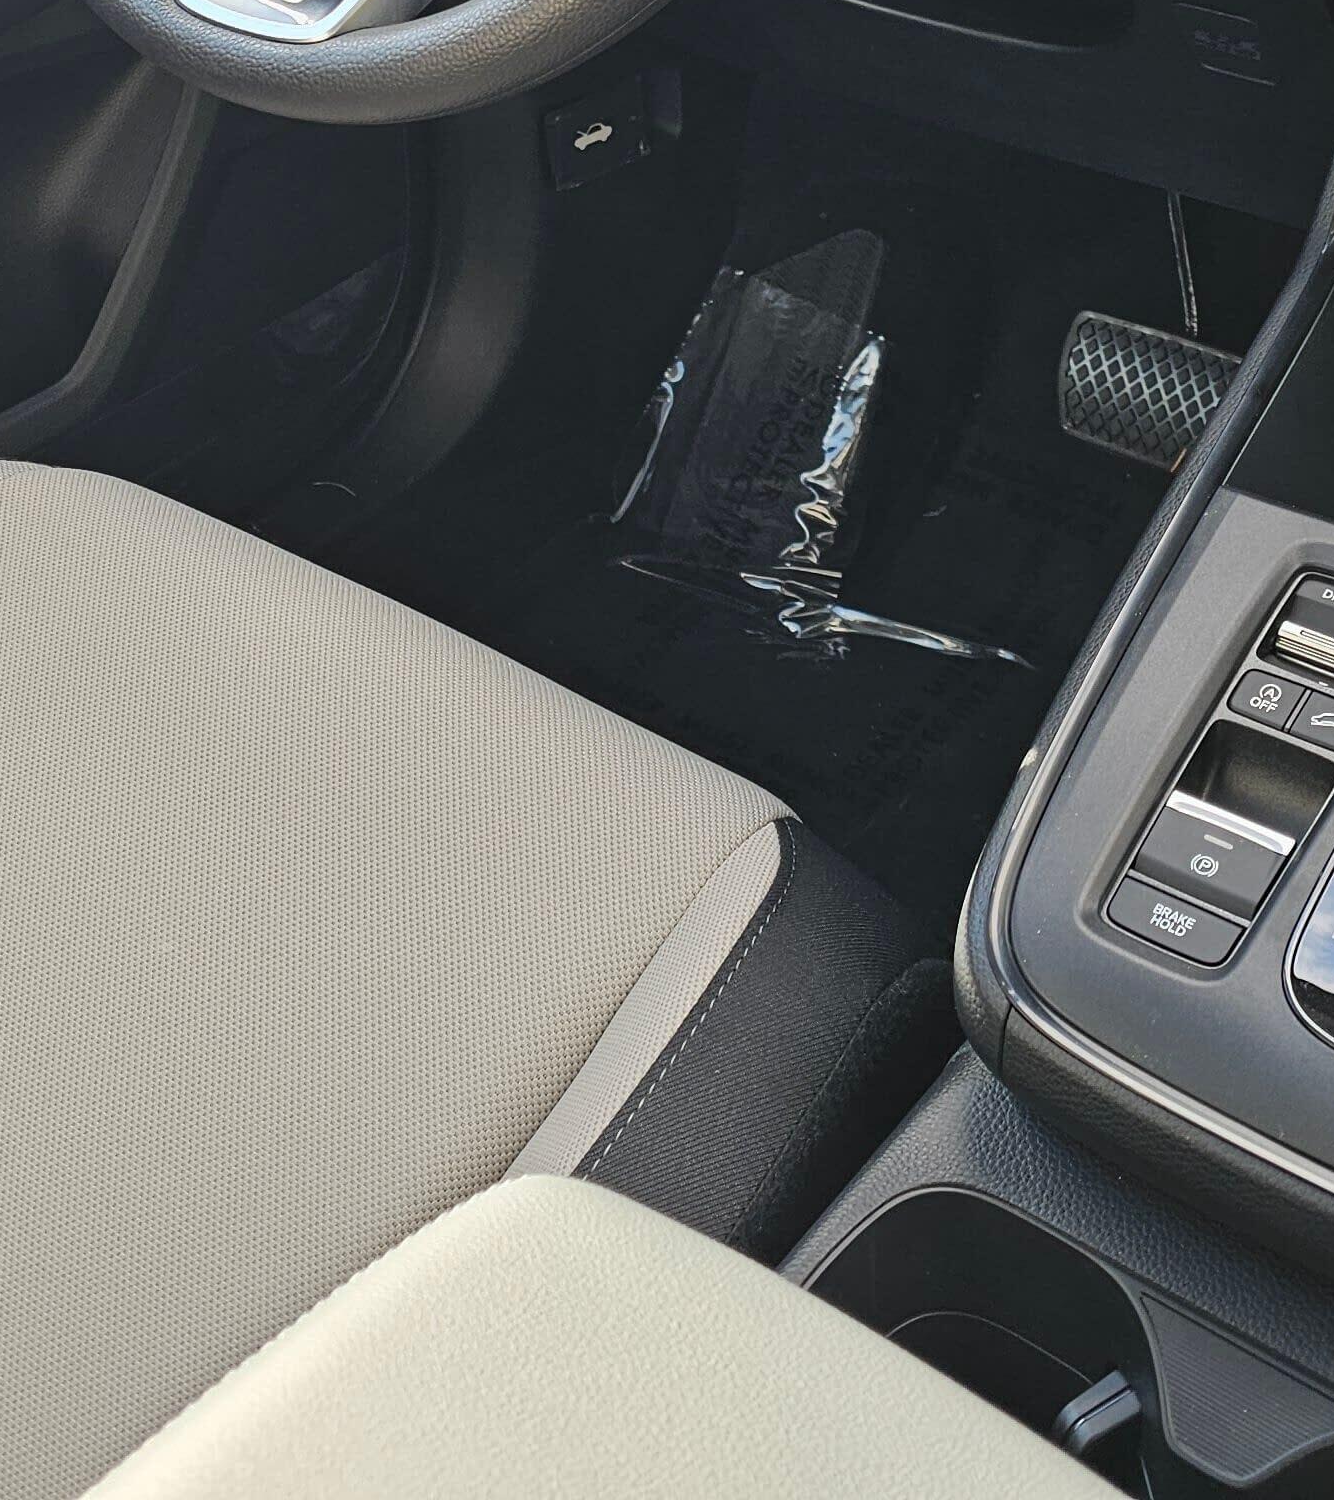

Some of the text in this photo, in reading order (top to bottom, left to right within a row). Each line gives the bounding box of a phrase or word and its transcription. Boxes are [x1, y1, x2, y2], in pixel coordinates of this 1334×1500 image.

[1249, 696, 1278, 713] OFF
[1149, 914, 1186, 937] HOLD
[1152, 902, 1197, 930] BRAKE
